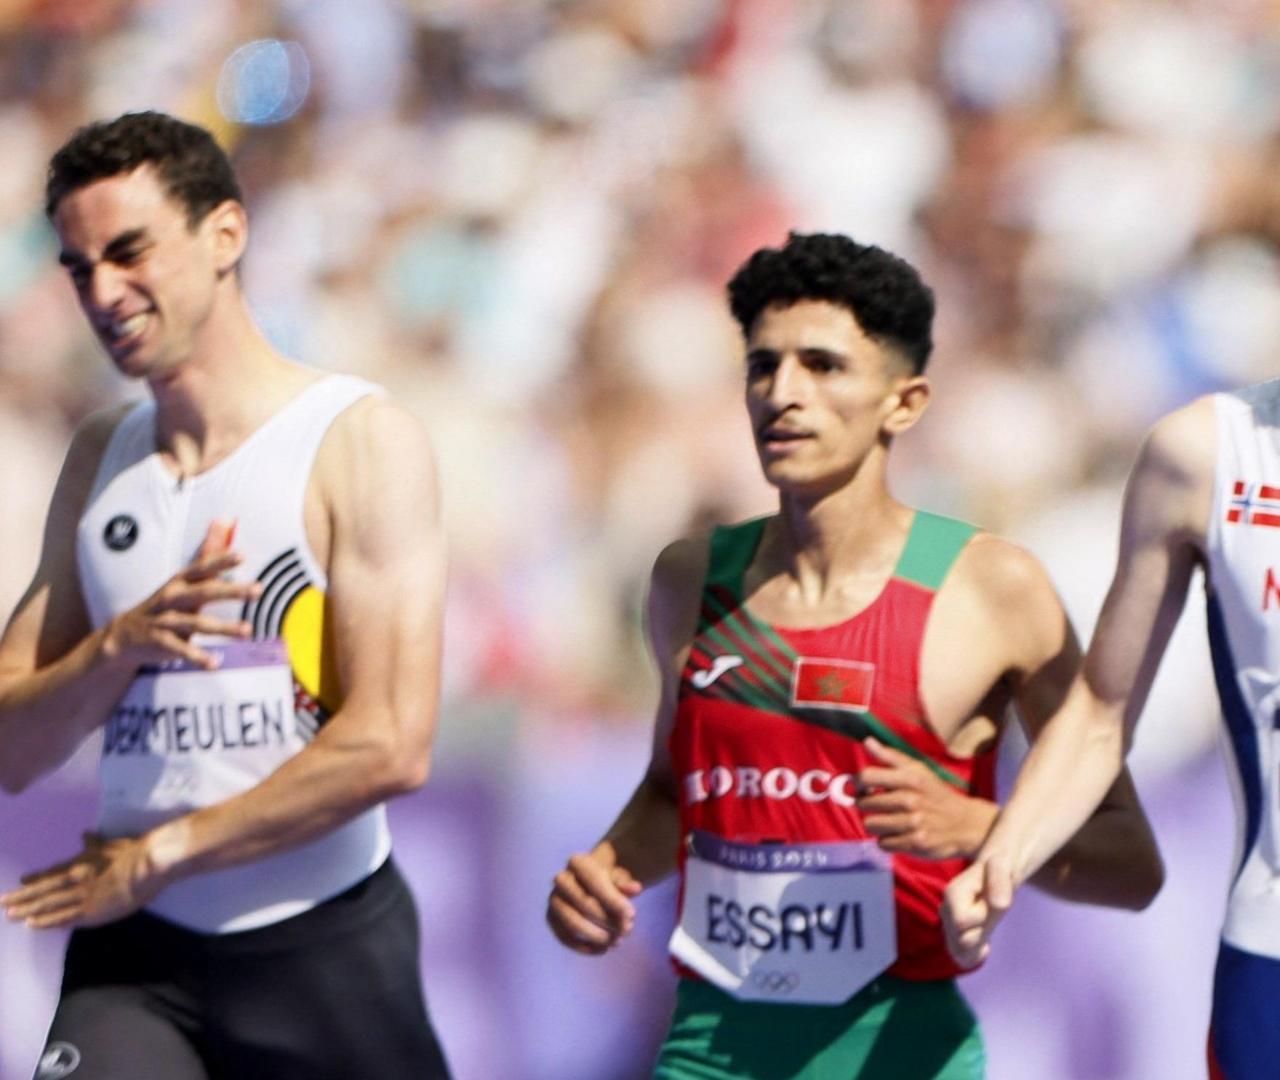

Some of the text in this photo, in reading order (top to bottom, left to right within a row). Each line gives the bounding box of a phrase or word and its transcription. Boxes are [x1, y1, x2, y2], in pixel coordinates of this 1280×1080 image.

[686, 765, 856, 807] OROCC
[771, 849, 828, 869] 2024
[707, 895, 864, 950] ESSAYI
